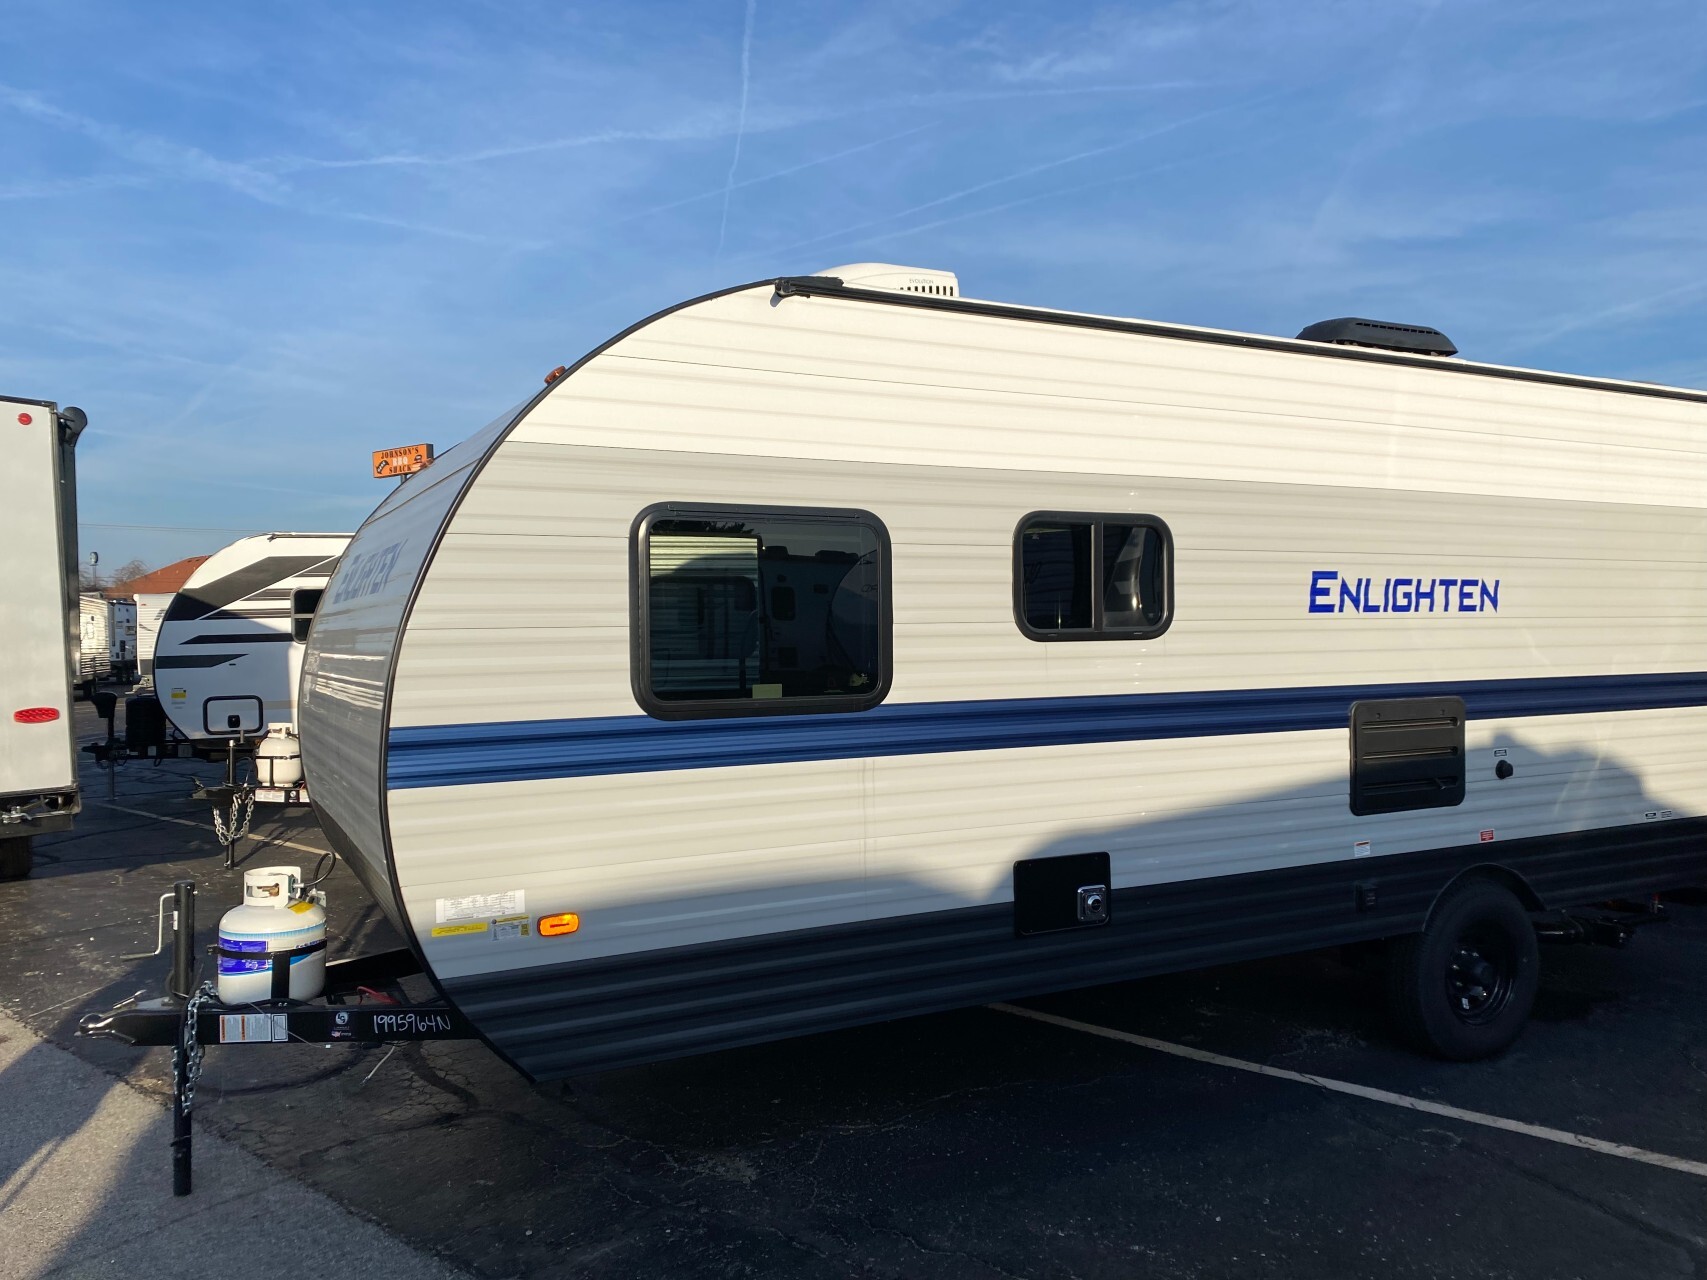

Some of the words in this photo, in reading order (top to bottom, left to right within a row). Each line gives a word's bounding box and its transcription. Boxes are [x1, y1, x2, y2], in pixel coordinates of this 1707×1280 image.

[381, 447, 419, 459] JOHNSON'S
[389, 464, 412, 475] SHACK
[1309, 571, 1499, 613] ENLIGHTEN
[373, 1013, 451, 1034] 1995964N
